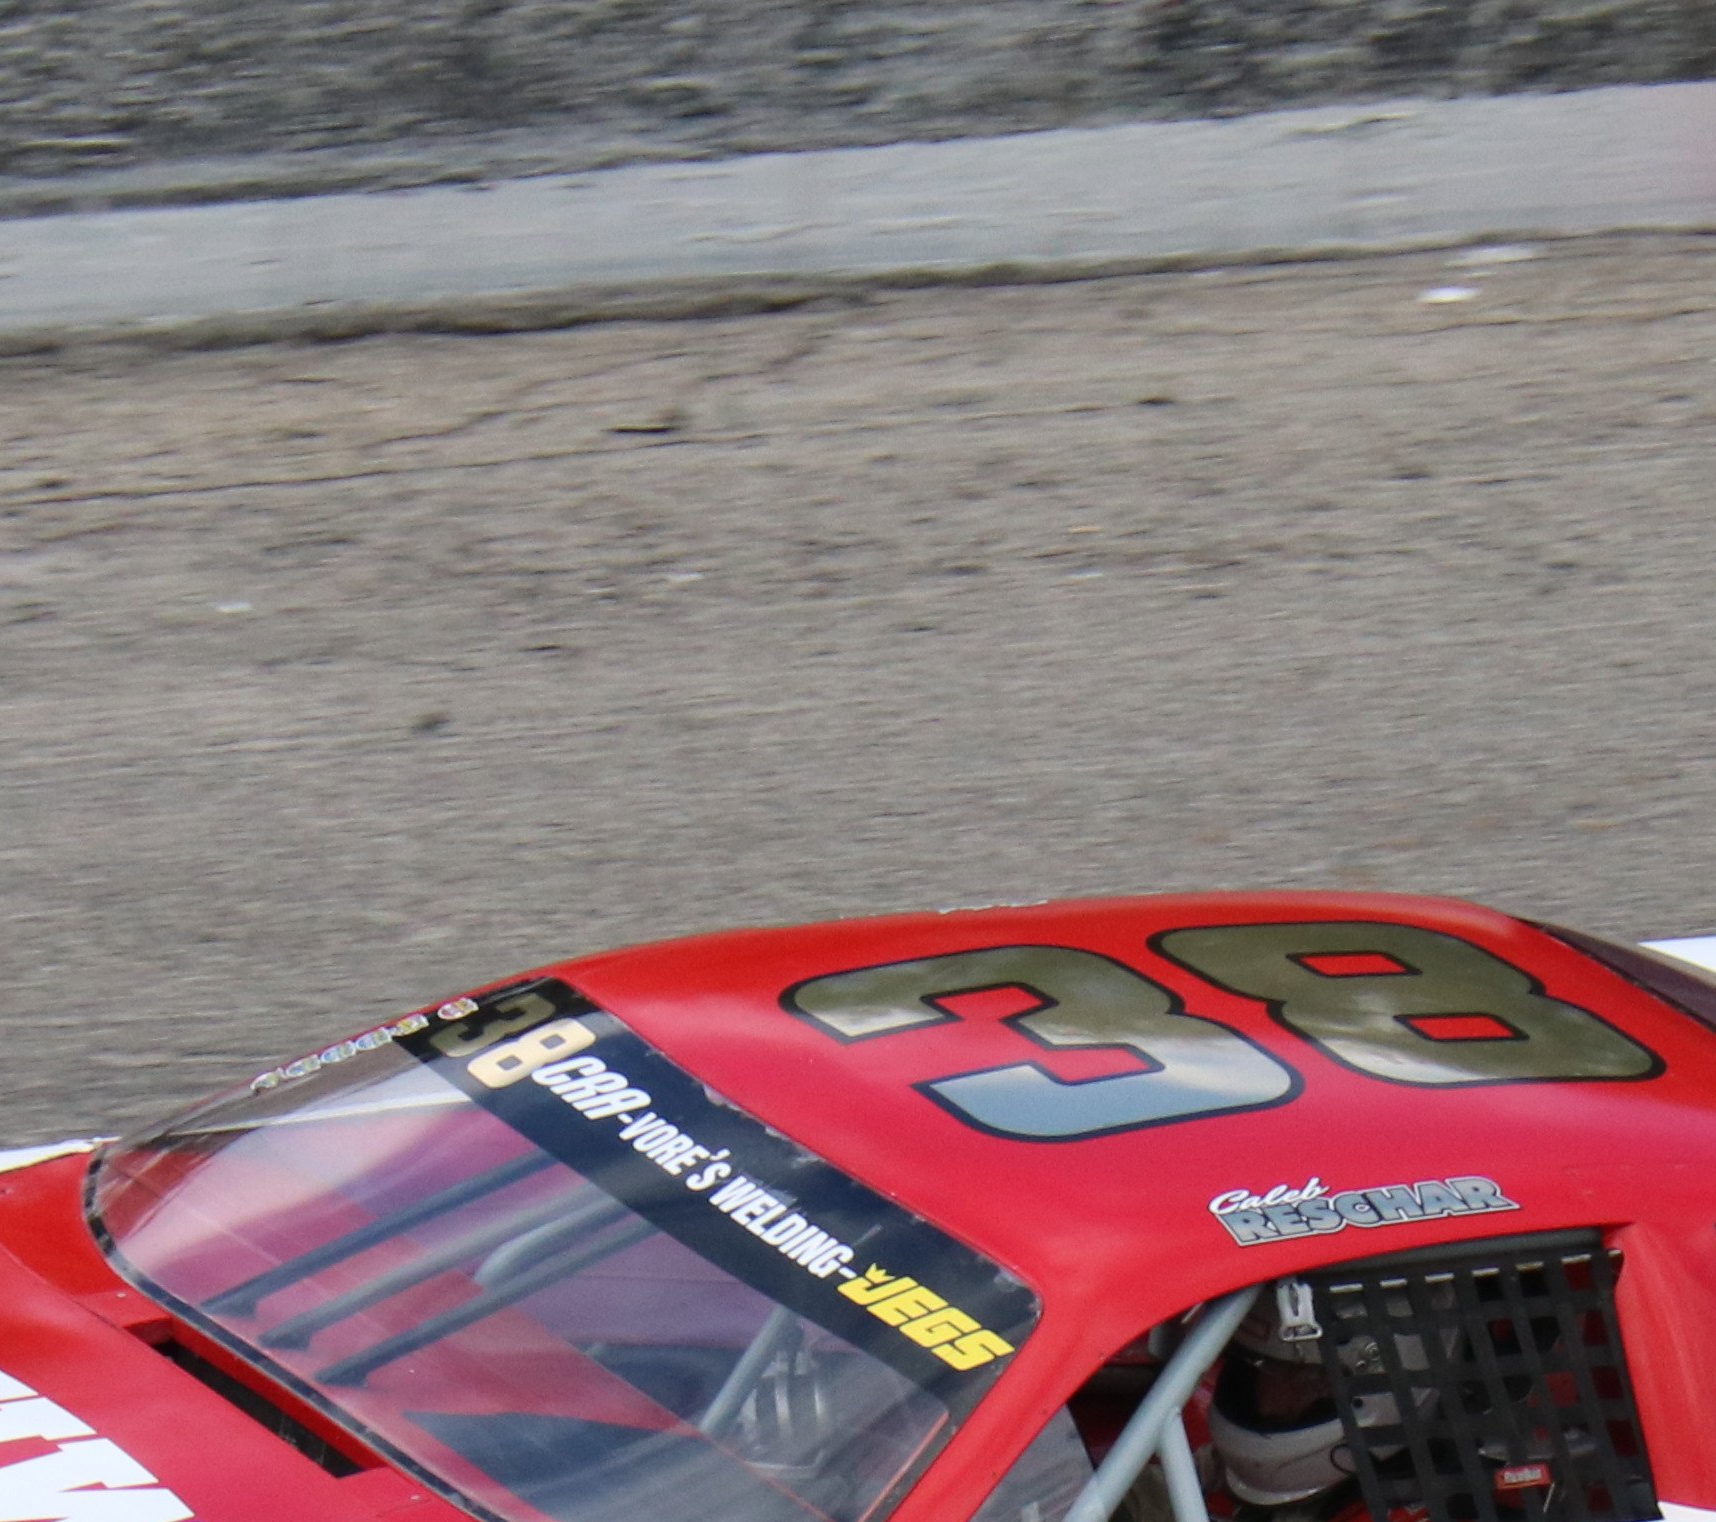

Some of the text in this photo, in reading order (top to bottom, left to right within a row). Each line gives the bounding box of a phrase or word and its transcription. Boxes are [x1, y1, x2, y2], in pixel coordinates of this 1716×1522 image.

[429, 993, 597, 1089] 38
[778, 921, 1667, 1143] 38
[1208, 1177, 1331, 1213] Caleb
[1216, 1176, 1519, 1245] RESCHAR
